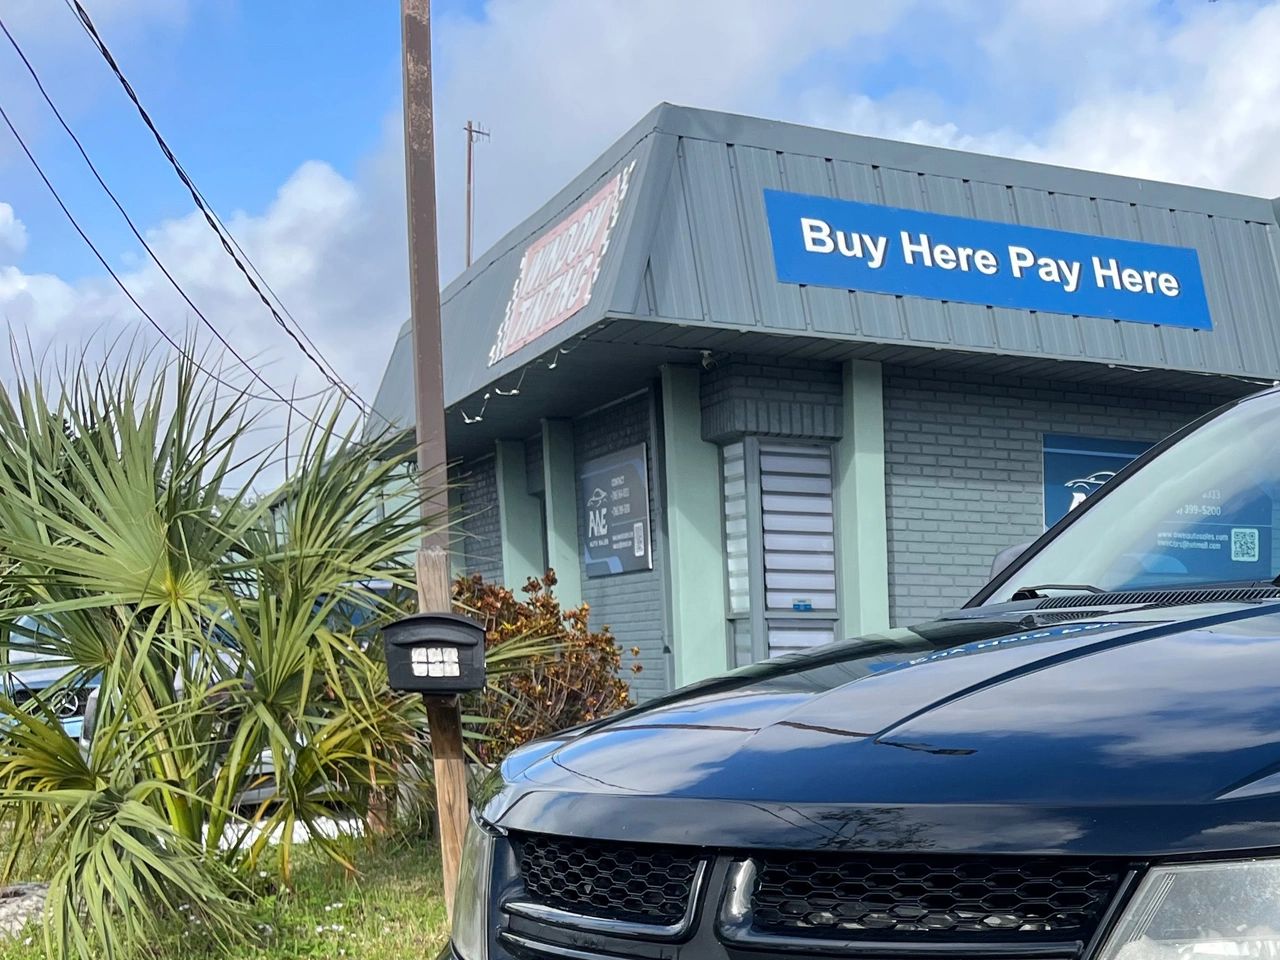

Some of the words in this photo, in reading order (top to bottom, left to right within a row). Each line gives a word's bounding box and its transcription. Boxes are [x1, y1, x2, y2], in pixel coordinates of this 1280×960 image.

[519, 193, 616, 297] WINDOW
[800, 217, 887, 269] Buy
[901, 231, 998, 275] Here
[1007, 246, 1082, 293] Pay
[1091, 256, 1180, 297] Here
[509, 252, 595, 345] TINTING
